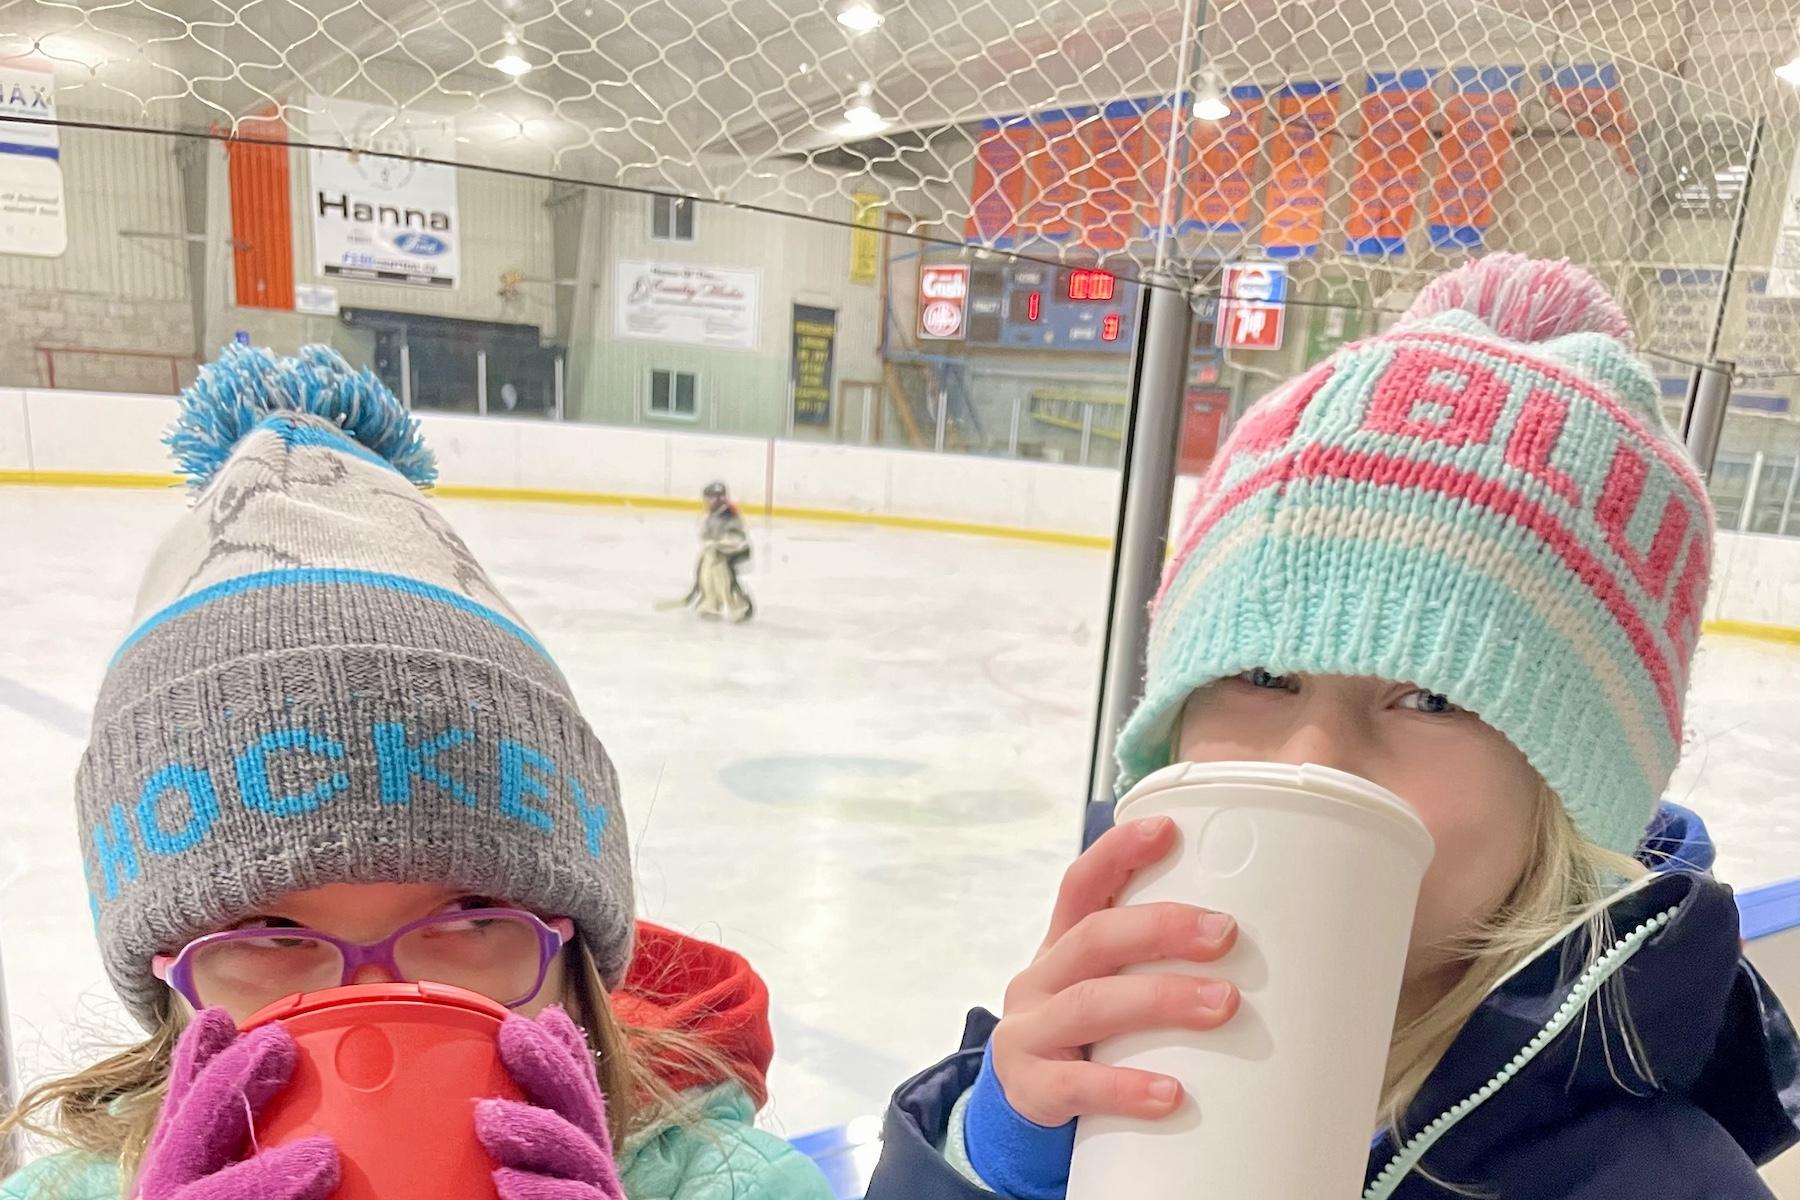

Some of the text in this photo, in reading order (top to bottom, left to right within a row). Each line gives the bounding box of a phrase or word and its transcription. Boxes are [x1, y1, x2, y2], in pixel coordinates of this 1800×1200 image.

[0, 83, 48, 109] AX
[318, 191, 451, 231] Hanna
[92, 721, 609, 902] HOCKEY
